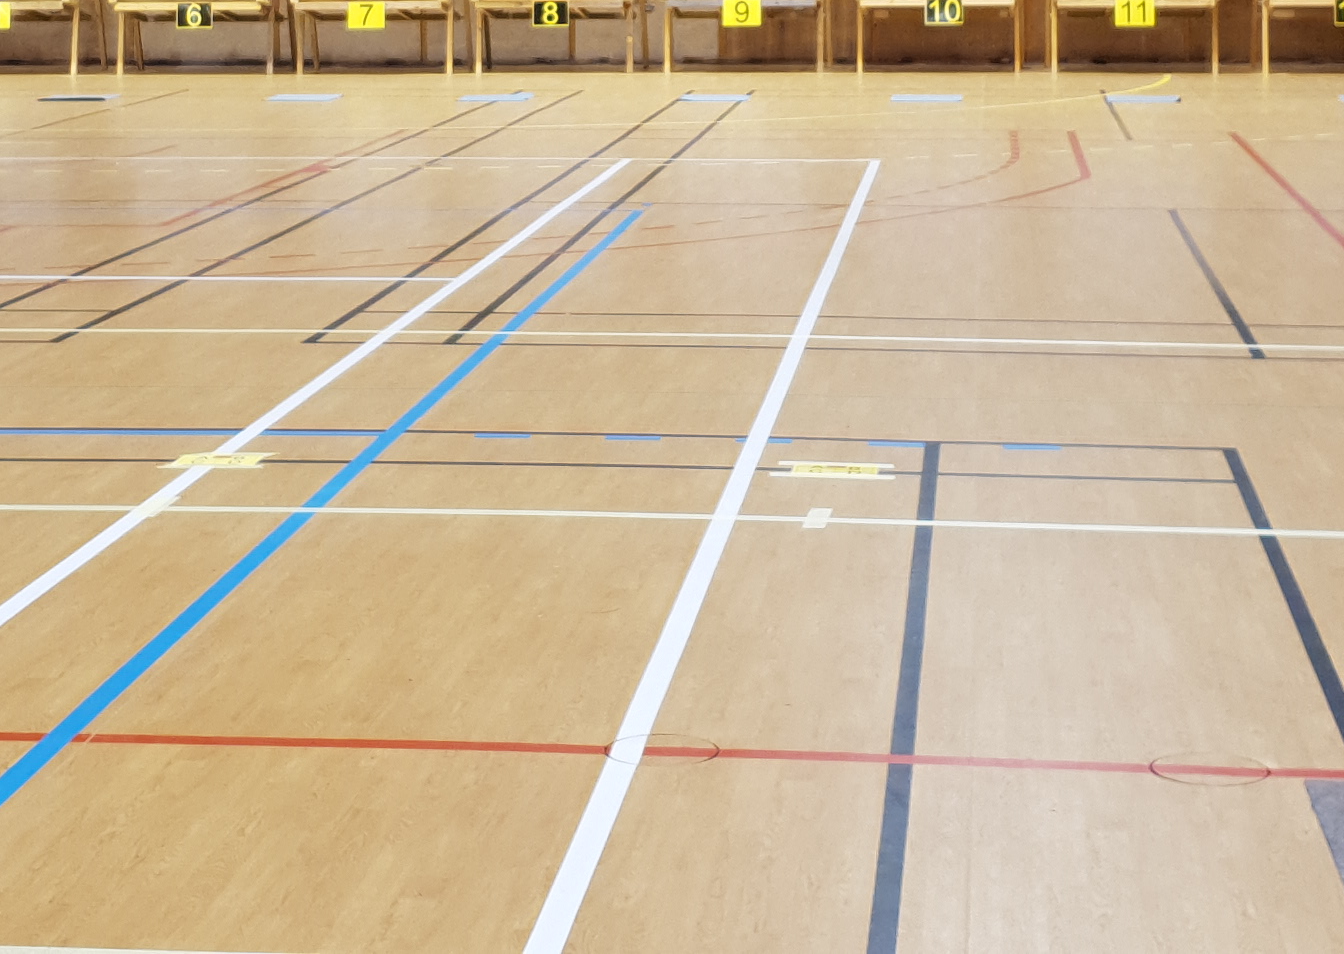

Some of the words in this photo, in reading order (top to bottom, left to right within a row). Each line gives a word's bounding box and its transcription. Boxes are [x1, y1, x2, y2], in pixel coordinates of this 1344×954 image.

[186, 3, 202, 27] 6
[360, 4, 374, 26] 7
[542, 1, 559, 25] 8
[734, 1, 749, 23] 9
[1121, 0, 1148, 23] 11
